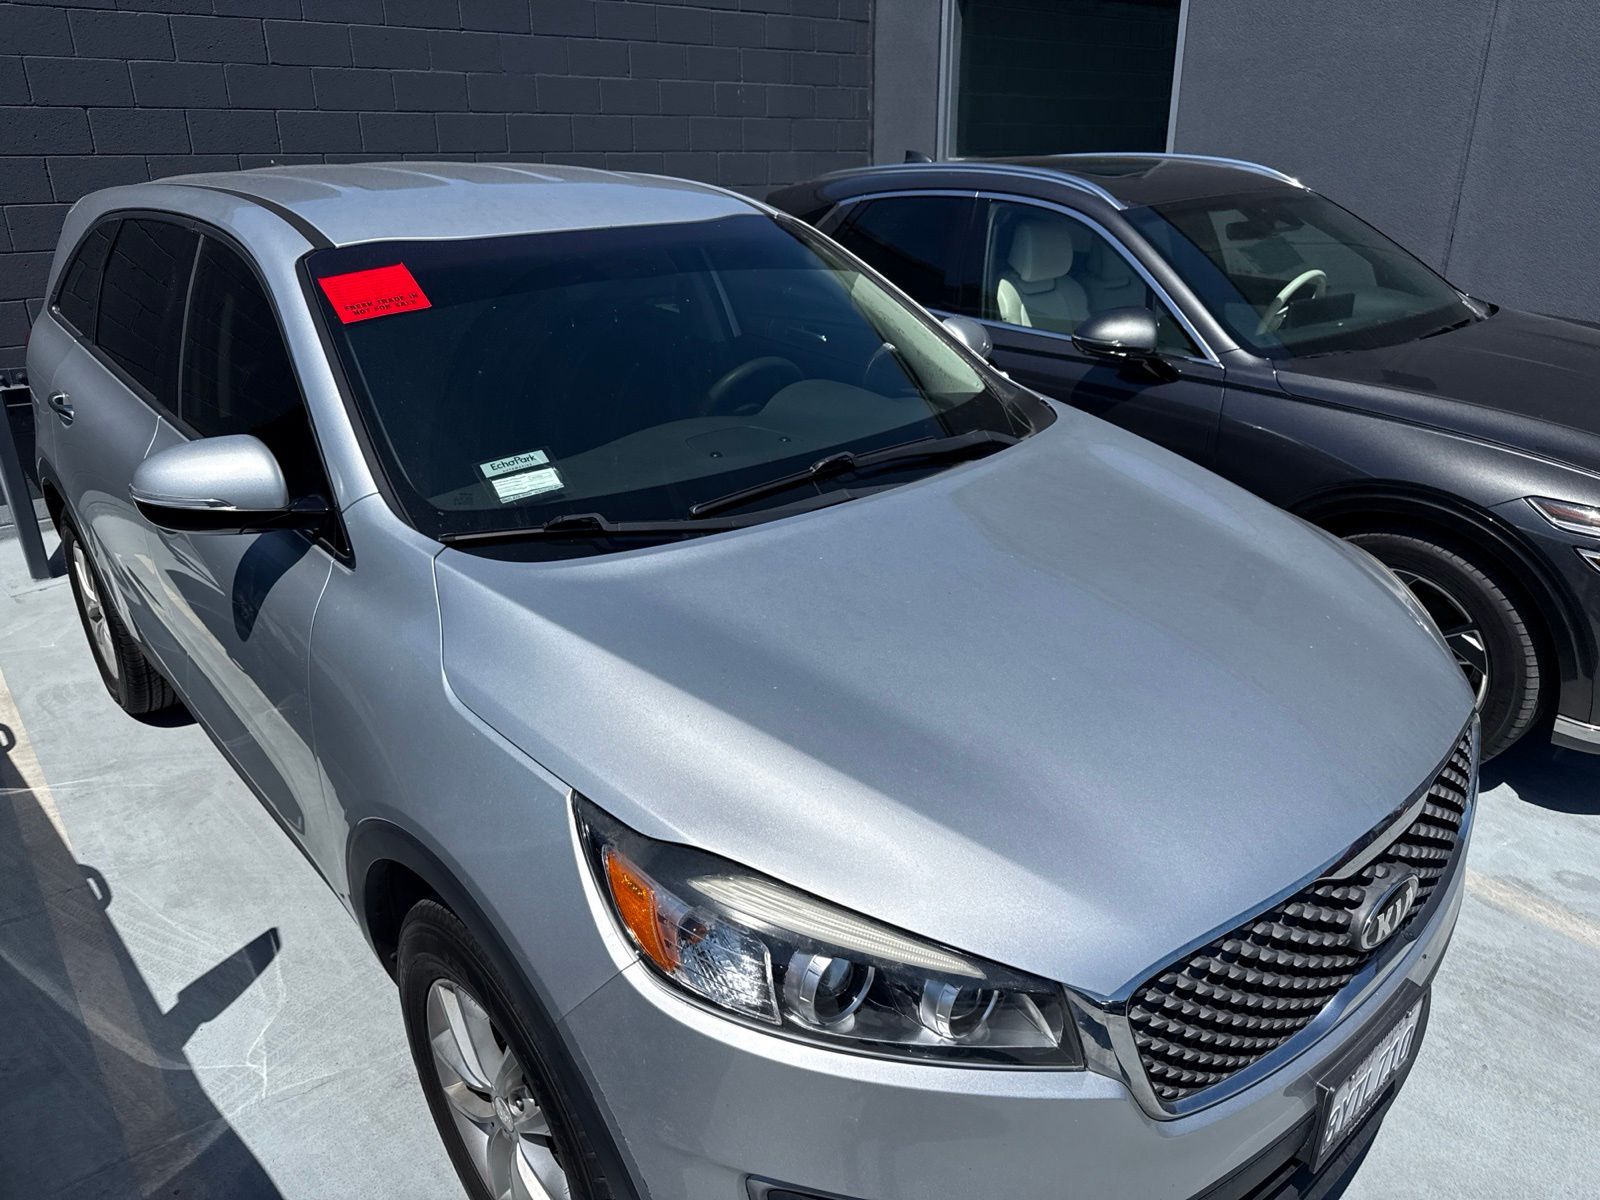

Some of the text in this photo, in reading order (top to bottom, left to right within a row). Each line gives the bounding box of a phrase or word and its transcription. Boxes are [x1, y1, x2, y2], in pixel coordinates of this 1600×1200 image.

[353, 307, 370, 316] NOT
[395, 299, 417, 308] SALE
[490, 454, 537, 471] EchoPark
